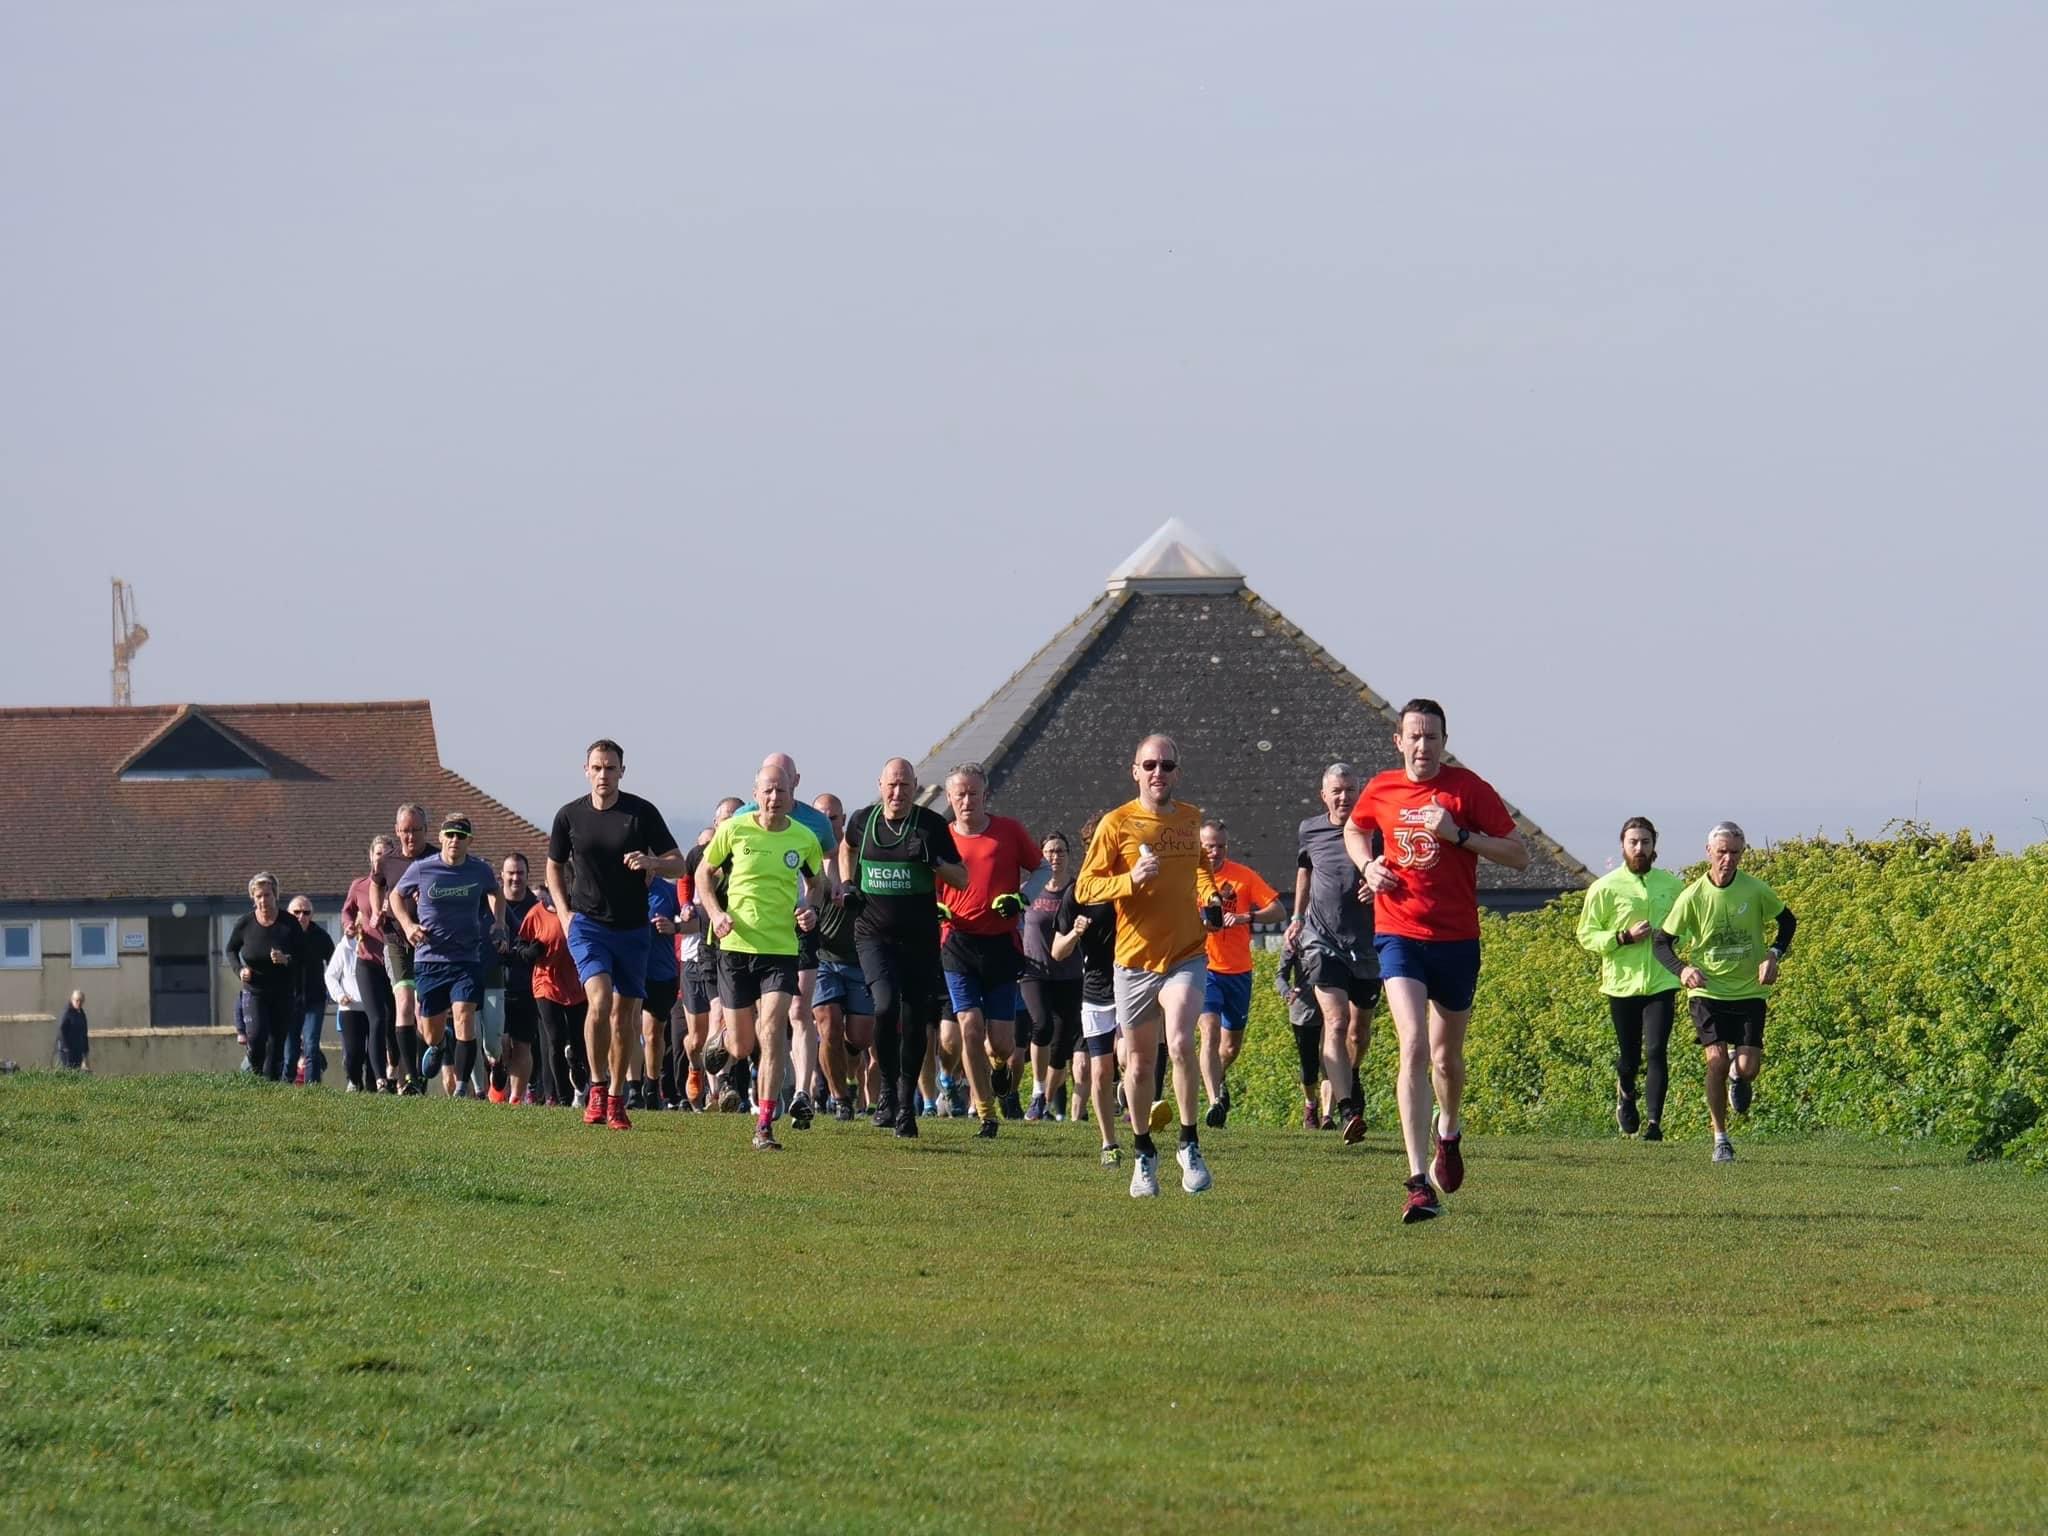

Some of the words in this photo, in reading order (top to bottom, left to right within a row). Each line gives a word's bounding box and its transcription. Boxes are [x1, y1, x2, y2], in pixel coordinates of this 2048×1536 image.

[1394, 827, 1439, 868] 30
[867, 867, 911, 880] VEGAN
[868, 880, 912, 889] RUNNERS
